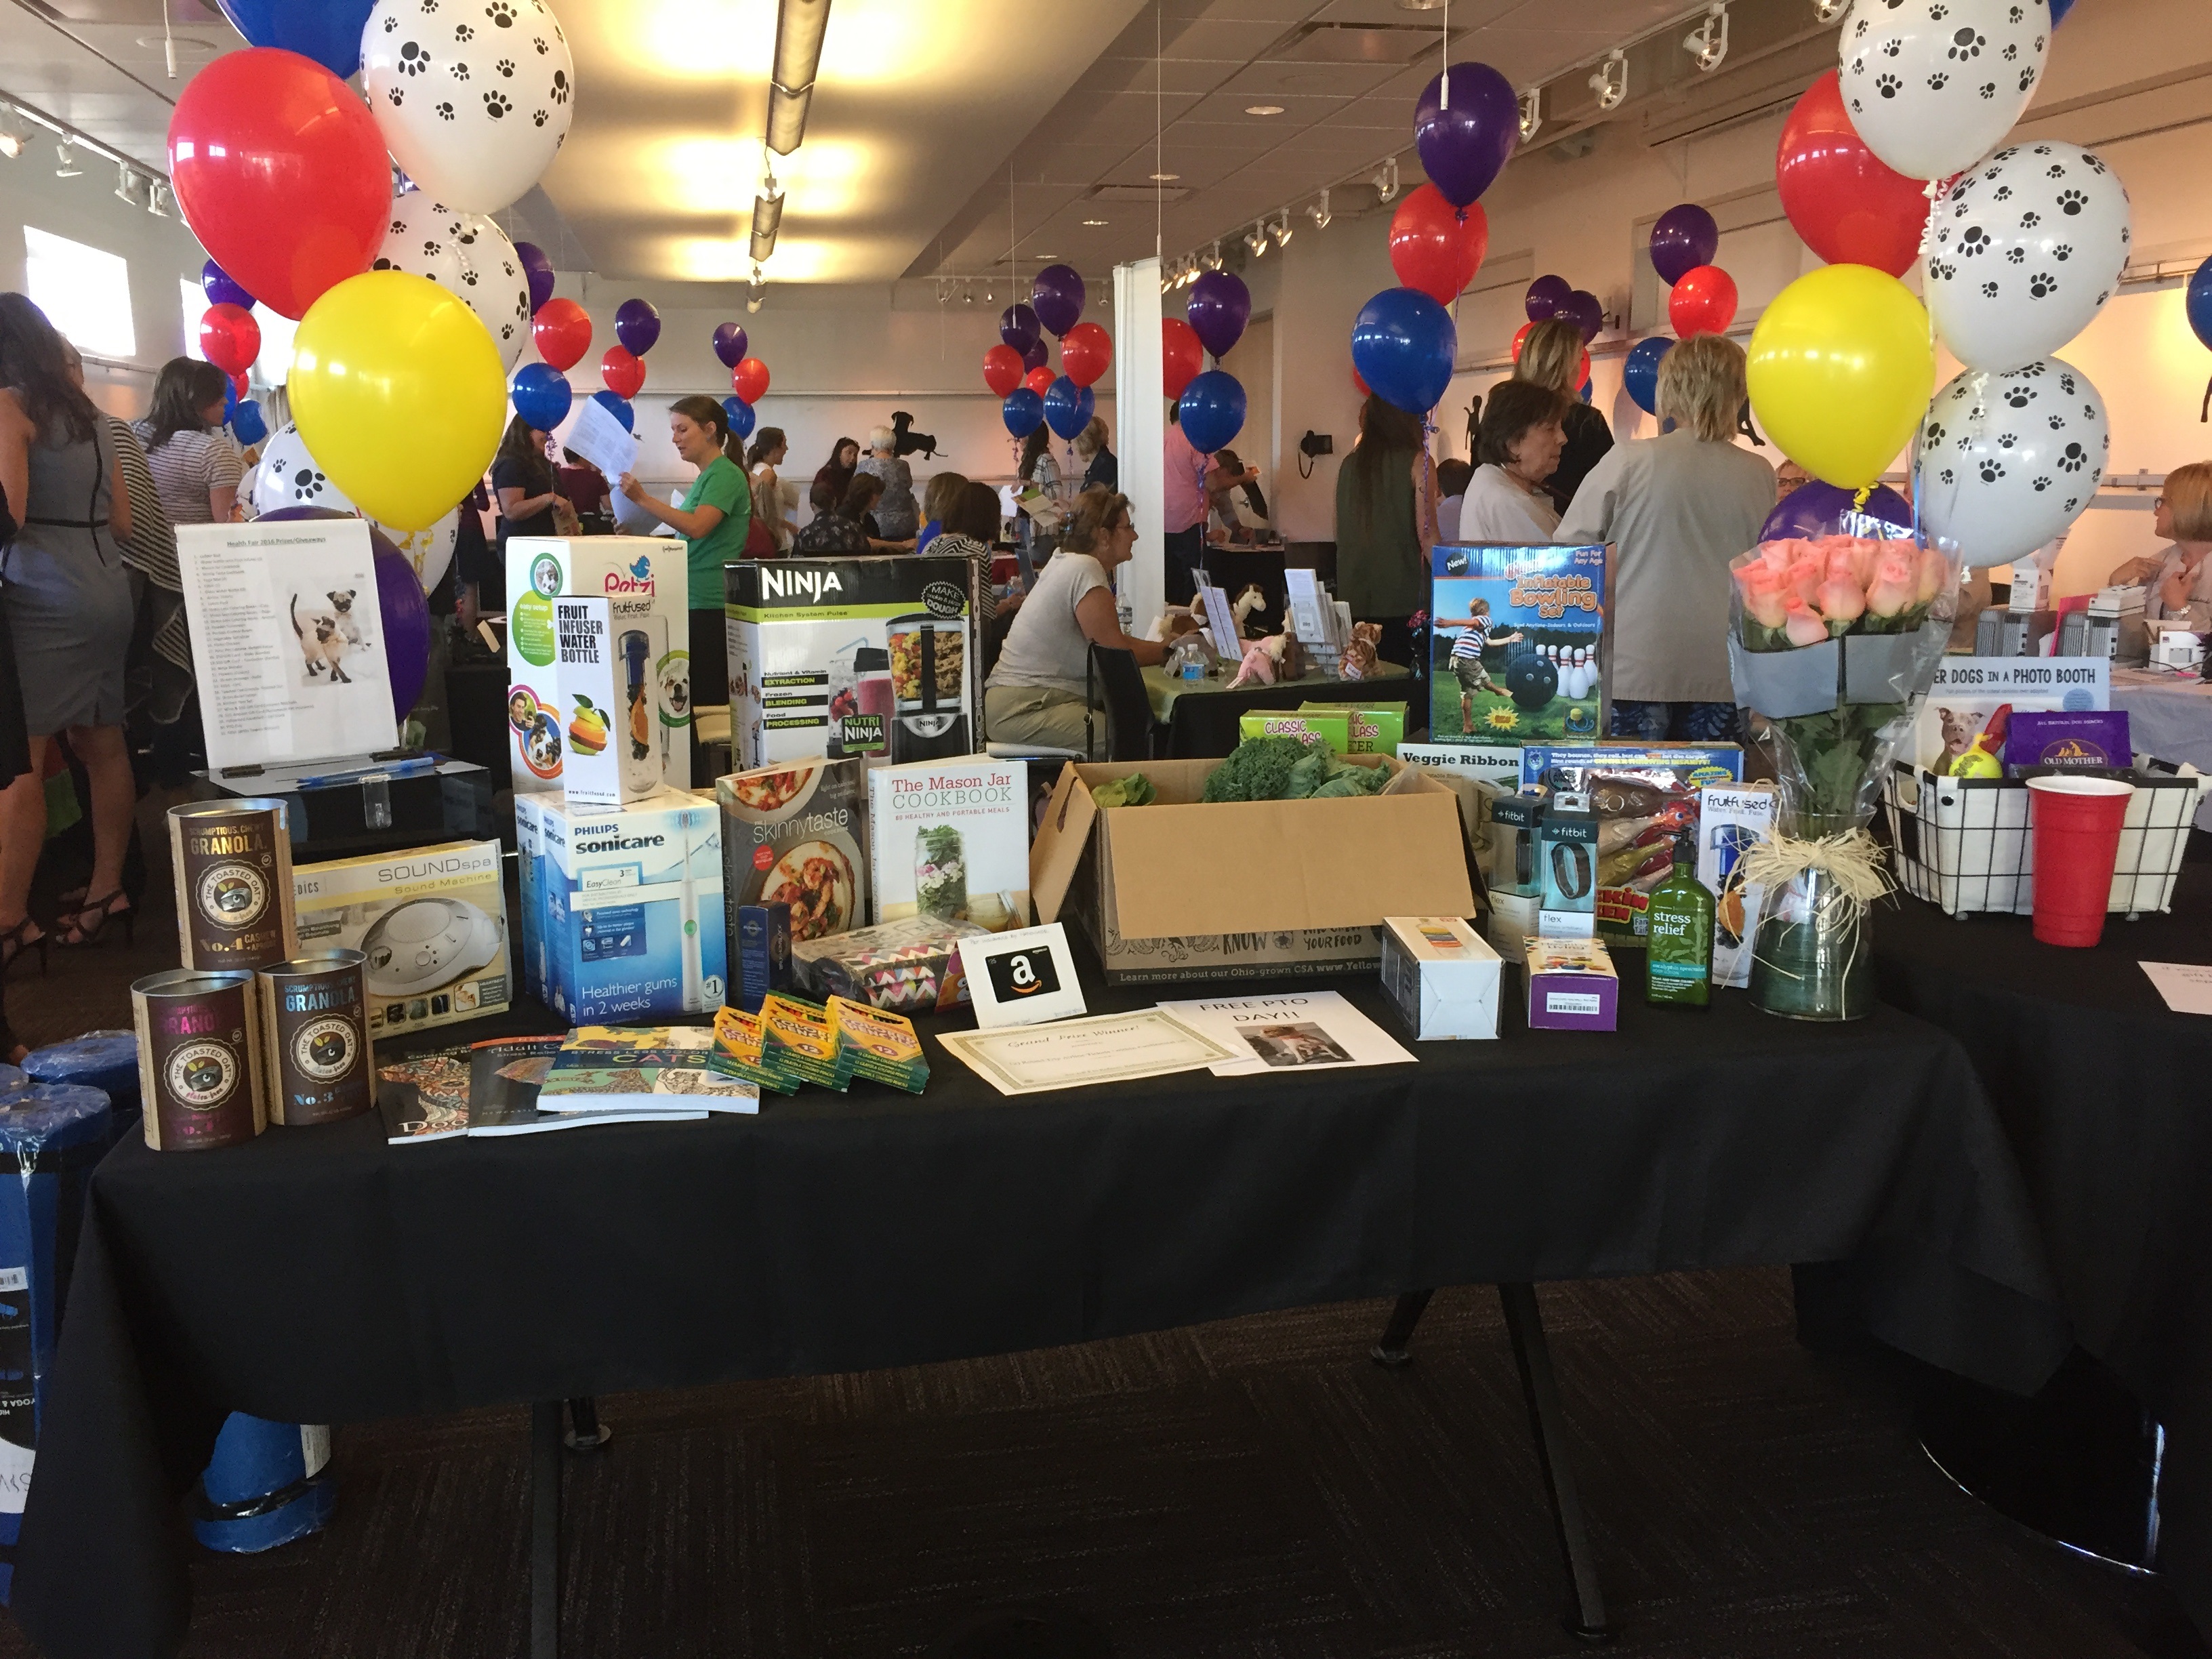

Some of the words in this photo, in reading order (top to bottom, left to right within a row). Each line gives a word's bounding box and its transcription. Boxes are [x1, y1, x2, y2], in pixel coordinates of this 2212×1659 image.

[1446, 557, 1469, 571] New!
[1574, 557, 1588, 566] Any
[761, 567, 844, 604] NINJA
[1517, 575, 1591, 589] Inflatable
[931, 586, 960, 601] MAKE
[1510, 588, 1597, 611] Bowling
[558, 605, 588, 619] FRUIT
[926, 599, 959, 614] DOUGH
[1539, 605, 1564, 617] Set
[558, 619, 604, 634] INFUSER
[559, 634, 596, 649] WATER
[560, 649, 600, 663] BOTTLE
[764, 677, 815, 687] EXTRACTION
[1933, 669, 1948, 684] ER
[1951, 669, 1984, 684] DOGS
[1988, 671, 2000, 682] IN
[2003, 670, 2010, 682] A
[2013, 668, 2052, 684] PHOTO
[2056, 668, 2096, 684] BOOTH
[765, 698, 807, 707] BLENDING
[766, 718, 819, 728] PROCESSING
[844, 716, 880, 726] NUTRI
[1265, 720, 1307, 734] CLASSIC
[844, 726, 882, 743] NINJA
[1403, 752, 1456, 766] Veggie
[1460, 754, 1519, 766] Ribbon
[2044, 757, 2062, 765] OLD
[2062, 756, 2104, 765] MOTHER
[1692, 769, 1727, 778] AMAZING
[892, 779, 924, 793] The
[928, 777, 983, 791] Mason
[987, 773, 1012, 787] Jar
[893, 786, 1012, 810] COOKBOOK
[952, 808, 985, 817] PORTABLE
[1504, 811, 1525, 822] fitbit
[575, 823, 619, 836] PHILIPS
[753, 806, 848, 844] skinnytaste
[1561, 827, 1587, 838] fitbit
[575, 834, 665, 855] sonicare
[377, 858, 491, 883] SOUNDspa
[205, 883, 213, 901] THE
[211, 867, 251, 884] TOASTED
[394, 881, 435, 895] Sound
[439, 873, 492, 887] Machine
[586, 878, 621, 889] EasyClean
[1491, 895, 1504, 905] flex
[1543, 914, 1562, 924] flex
[1654, 912, 1692, 924] stress
[1654, 924, 1687, 936] relief
[1304, 937, 1333, 951] YOUR
[1334, 934, 1362, 947] FOOD
[1120, 972, 1149, 982] Learn
[1151, 971, 1179, 981] more
[1179, 969, 1208, 979] about
[1230, 966, 1292, 978] Ohio-grown
[1294, 964, 1314, 973] CSA
[582, 982, 642, 1000] Healthier
[644, 977, 678, 995] gums
[705, 979, 718, 994] #1
[583, 1004, 594, 1017] in
[598, 1001, 608, 1015] 2
[611, 998, 651, 1012] weeks
[1199, 1002, 1253, 1012] FREE
[1261, 998, 1309, 1007] PTO
[1232, 1010, 1300, 1023] DAY!!
[301, 1038, 310, 1055] THE
[308, 1023, 346, 1040] TOASTED
[1008, 1037, 1050, 1048] Grand
[1059, 1033, 1087, 1041] Prize
[1092, 1024, 1140, 1038] Winner!
[408, 1050, 457, 1060] Coloring
[488, 1044, 537, 1054] Adult
[802, 1044, 819, 1054] 12
[876, 1046, 895, 1056] 12
[174, 1063, 184, 1081] THE
[180, 1048, 222, 1064] TOASTED
[612, 1054, 707, 1064] CATS
[293, 1090, 335, 1106] No.3
[398, 1119, 468, 1133] Doo
[1, 1400, 8, 1408] &
[9, 1398, 35, 1408] YOGA
